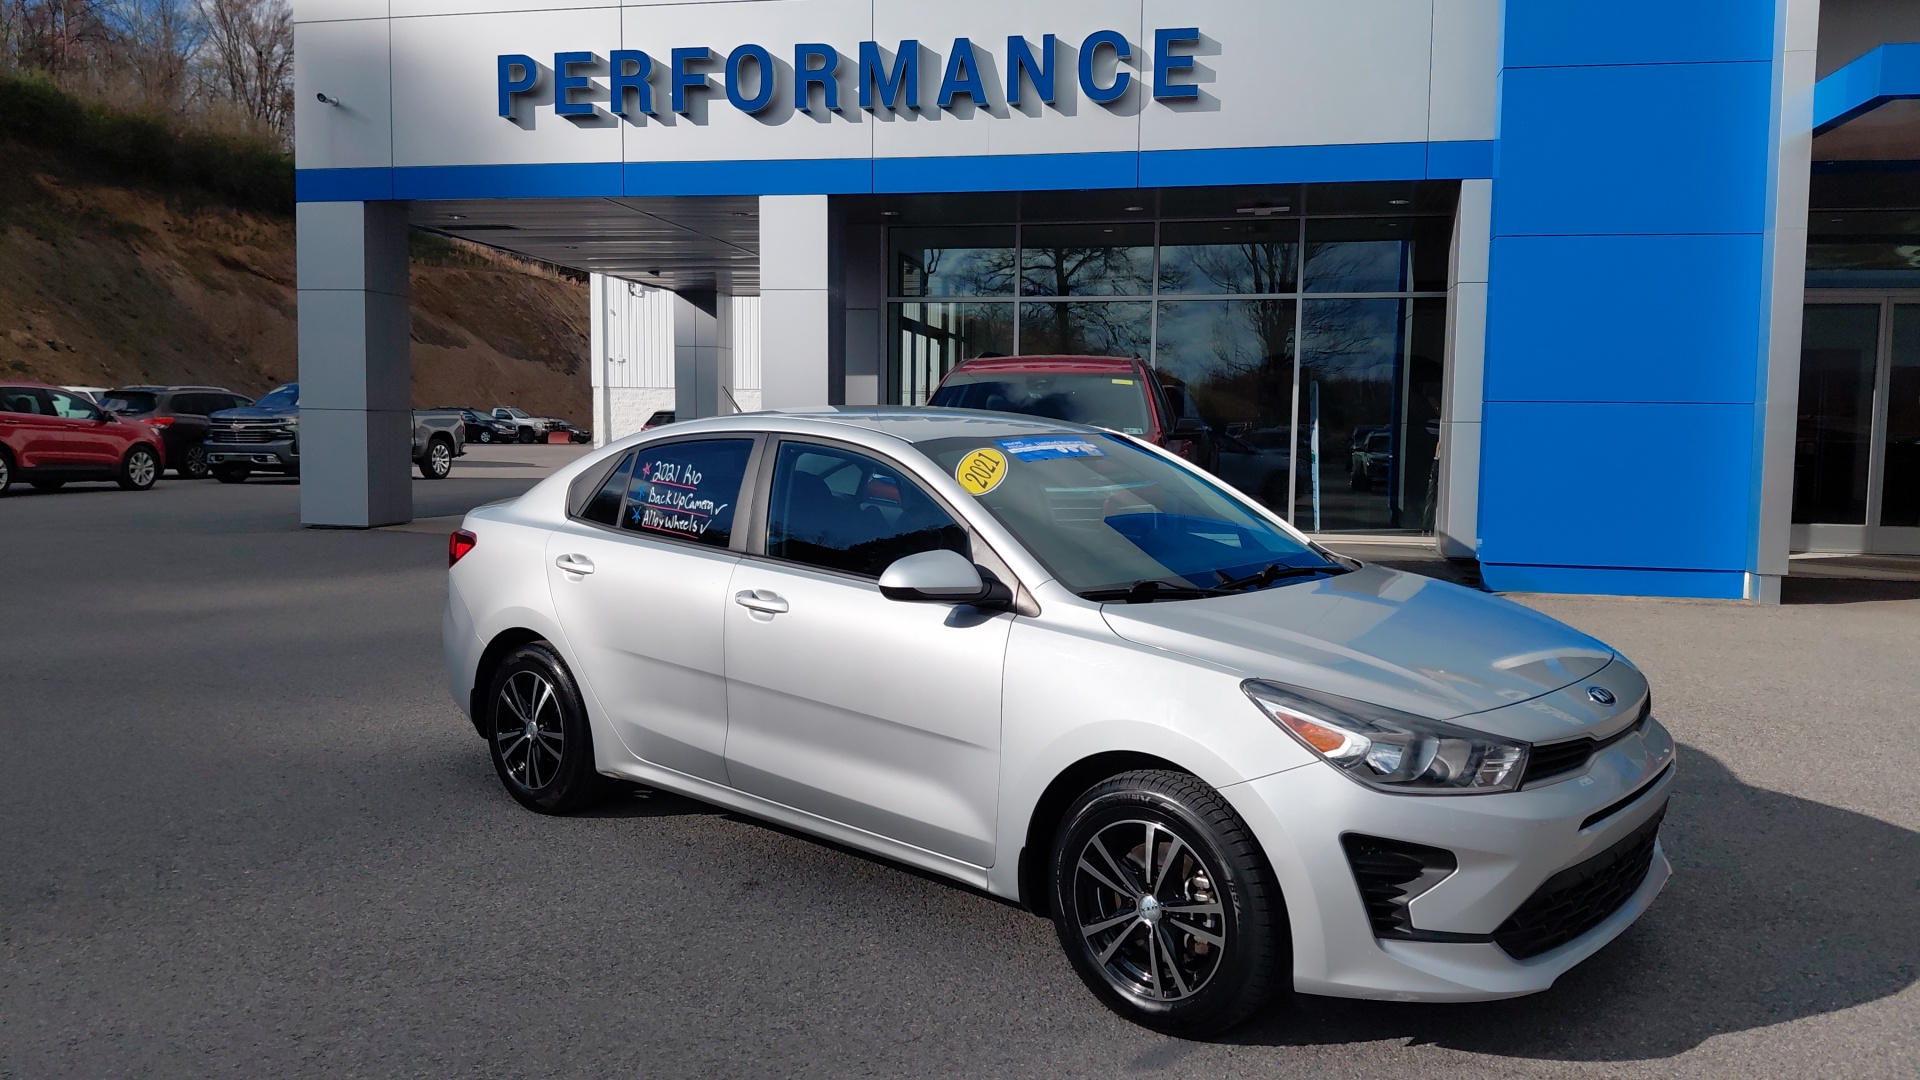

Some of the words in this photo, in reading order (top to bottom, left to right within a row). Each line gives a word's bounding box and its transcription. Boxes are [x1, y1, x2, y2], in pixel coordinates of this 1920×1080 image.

[497, 28, 1200, 120] PERFORMANCE
[652, 461, 681, 483] 2021
[964, 452, 1000, 490] 2021
